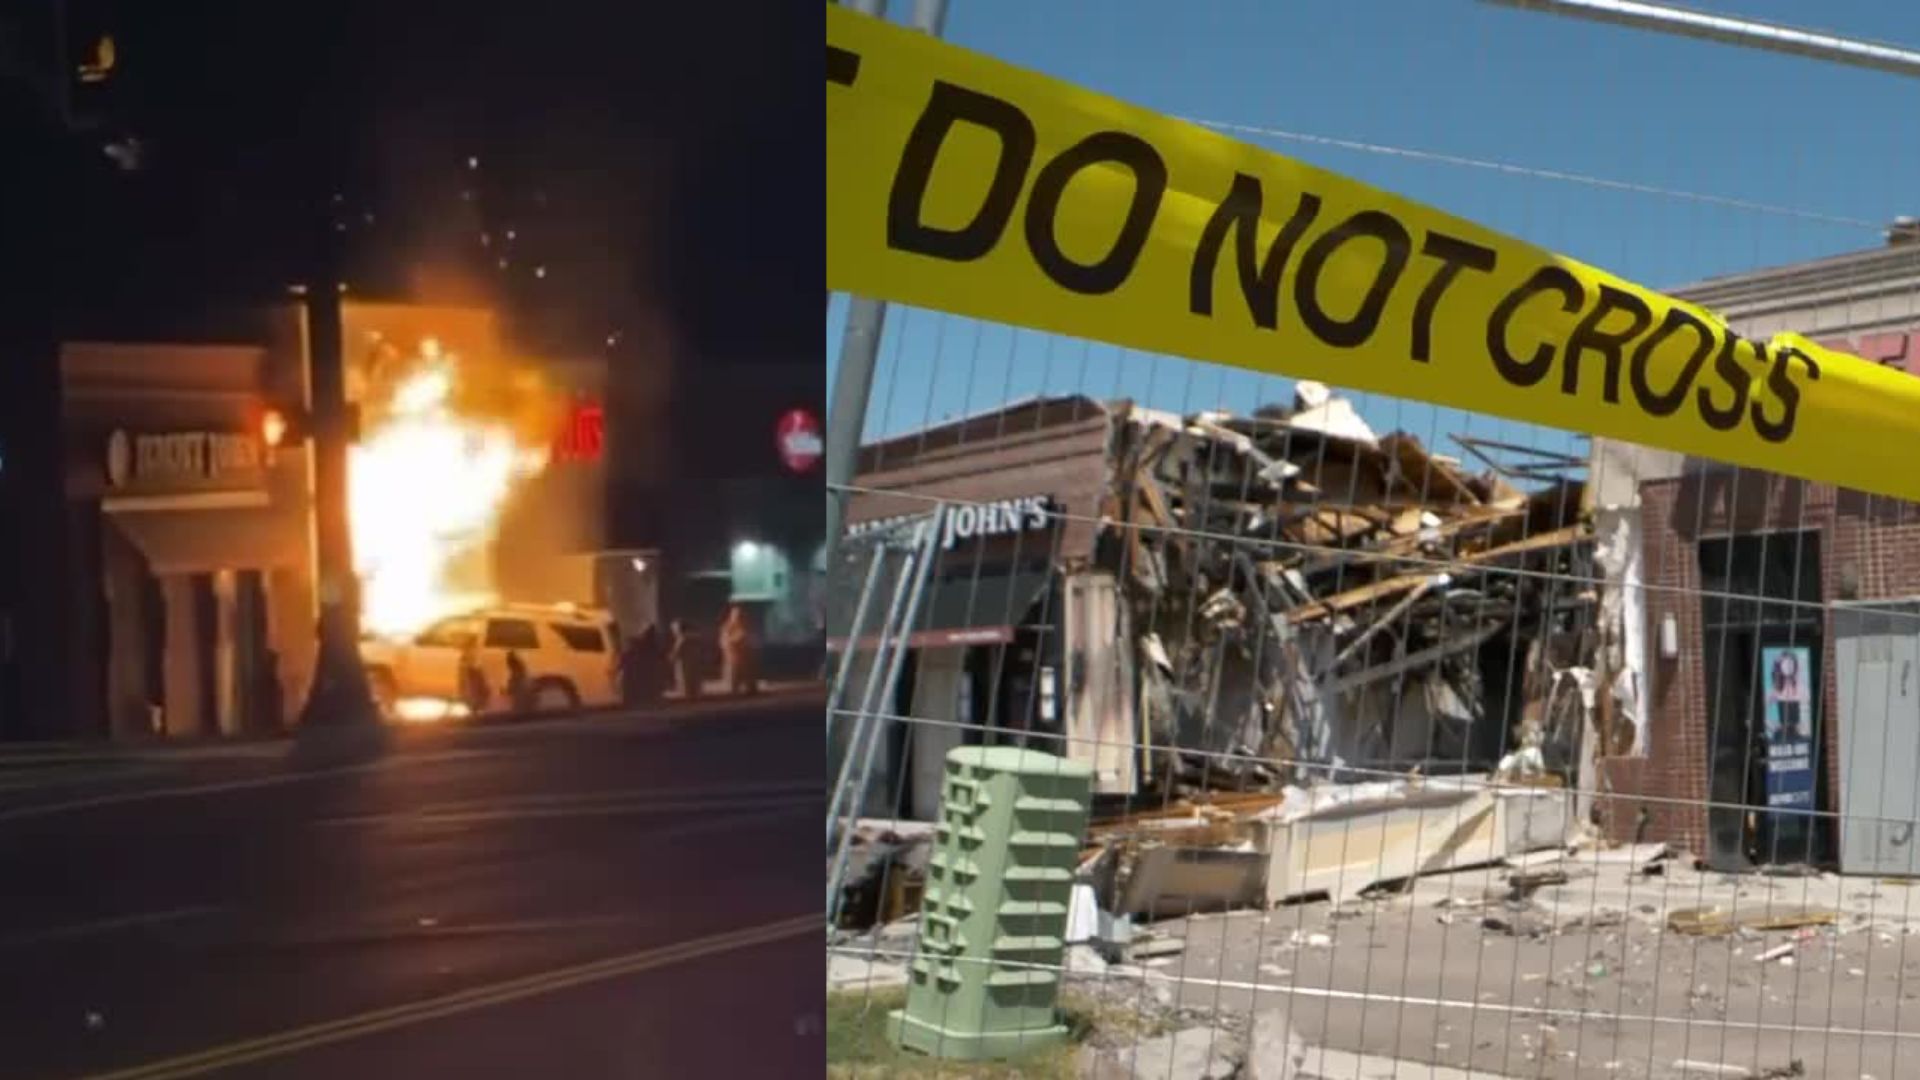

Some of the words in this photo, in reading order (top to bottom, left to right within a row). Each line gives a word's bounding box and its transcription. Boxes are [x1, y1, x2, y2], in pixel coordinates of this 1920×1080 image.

[887, 80, 1167, 295] DO
[1190, 173, 1497, 363] NOT
[1486, 266, 1820, 443] CROSS
[942, 495, 1049, 550] JOHN'S
